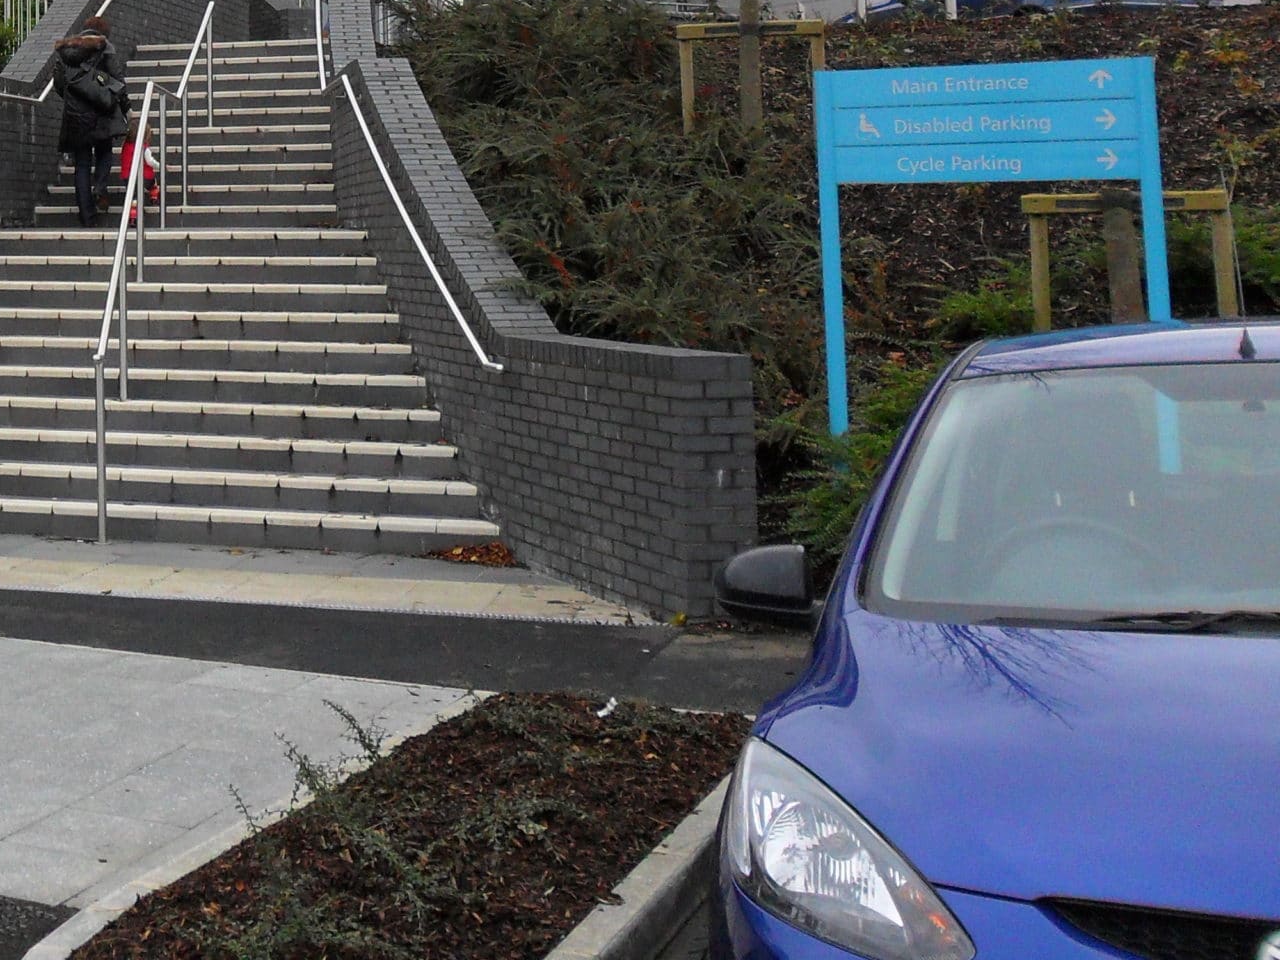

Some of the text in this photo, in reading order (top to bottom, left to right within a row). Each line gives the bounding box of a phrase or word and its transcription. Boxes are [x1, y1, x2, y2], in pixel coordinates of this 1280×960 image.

[891, 76, 1029, 95] Main Entrance
[894, 113, 1052, 135] Disabled Parking
[897, 154, 1023, 176] Cycle Parking
